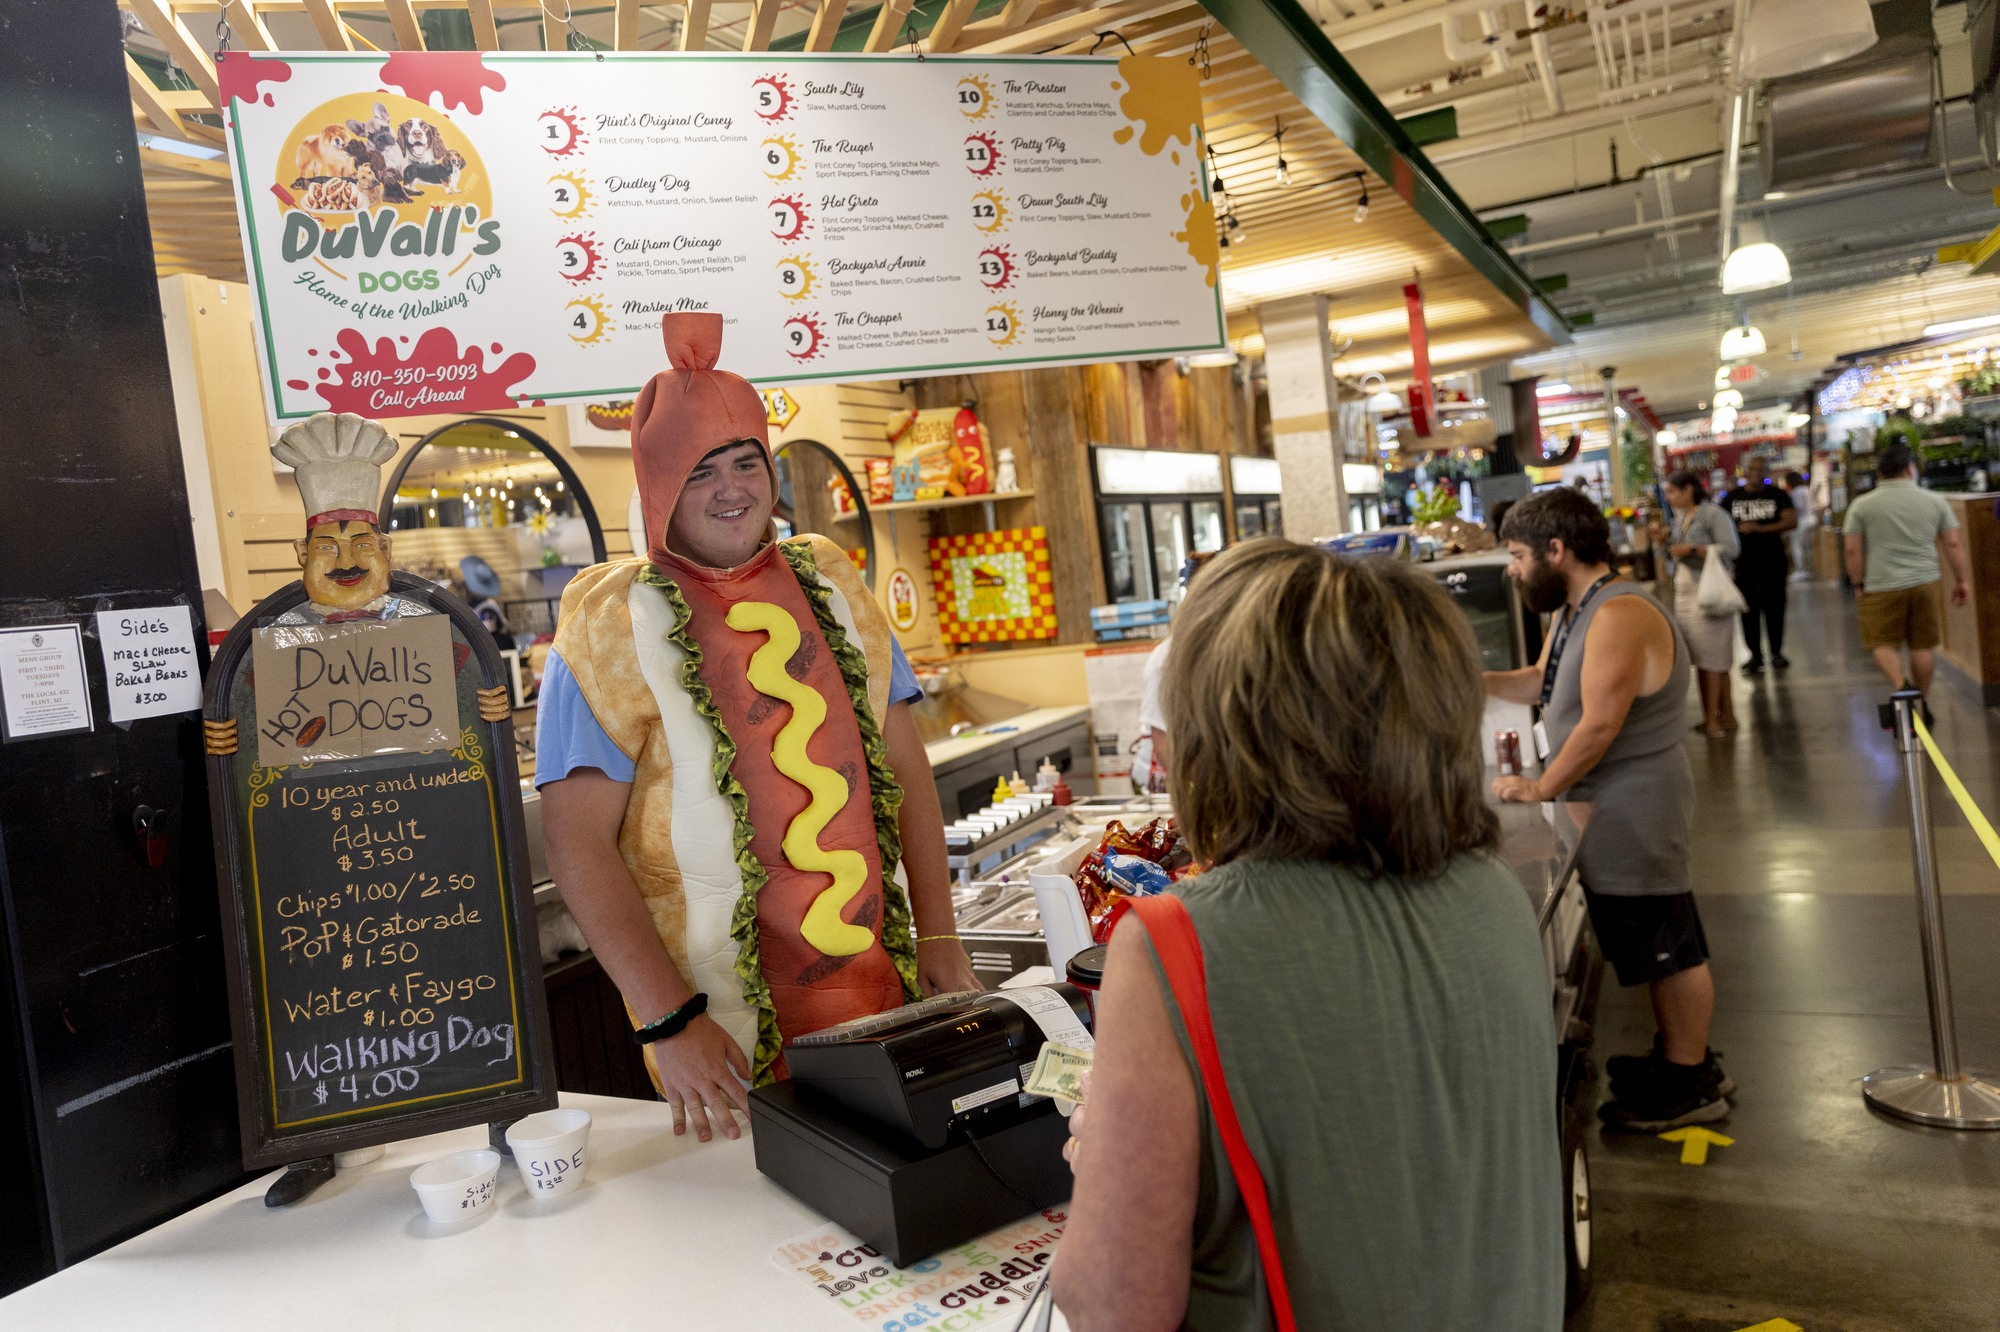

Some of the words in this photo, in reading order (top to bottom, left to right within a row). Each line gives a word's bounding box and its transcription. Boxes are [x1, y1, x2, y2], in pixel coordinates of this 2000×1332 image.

[759, 92, 772, 106] 5
[803, 81, 837, 97] South
[840, 81, 864, 98] Lily
[959, 91, 980, 103] 10
[1004, 80, 1022, 93] The
[1025, 81, 1066, 93] Preston
[547, 125, 559, 138] 1
[596, 114, 636, 131] Flint's
[639, 113, 691, 129] Original
[694, 113, 733, 129] Coney
[620, 137, 644, 145] Coney
[646, 136, 681, 144] Topping,
[721, 134, 747, 142] Onions
[767, 151, 779, 164] 6
[813, 140, 832, 153] The
[836, 140, 873, 155] Ruger
[966, 148, 987, 161] 11
[1011, 138, 1042, 153] Patty
[1045, 137, 1066, 152] Pig
[857, 161, 888, 169] Topping,
[871, 169, 900, 177] Flaming
[554, 188, 569, 202] 2
[605, 176, 656, 193] Dudley
[660, 174, 690, 191] Dog
[608, 199, 643, 207] Ketchup,
[775, 212, 787, 227] 7
[821, 195, 845, 211] Hot
[848, 195, 878, 211] Greta
[973, 205, 994, 218] 12
[1018, 194, 1053, 209] Down
[1054, 193, 1084, 208] South
[1086, 193, 1108, 208] Lily
[281, 205, 501, 263] DuVall's
[563, 251, 578, 266] 3
[614, 237, 639, 253] Cali
[642, 239, 670, 253] from
[673, 235, 722, 253] Chicago
[617, 260, 651, 268] Mustard,
[980, 262, 1001, 275] 13
[1025, 250, 1078, 266] Backyard
[1080, 248, 1117, 264] Buddy
[358, 269, 440, 294] DOGS
[618, 269, 644, 277] Pickle,
[679, 267, 701, 275] Sport
[703, 265, 734, 274] Peppers
[783, 271, 795, 284] 8
[828, 258, 887, 274] Backyard
[887, 256, 926, 271] Annie
[293, 270, 348, 308] Home
[351, 302, 368, 319] of
[369, 304, 394, 319] the
[398, 292, 469, 320] Walking
[466, 264, 501, 294] Dog
[573, 313, 587, 329] 4
[622, 300, 672, 313] Marley
[676, 297, 708, 311] Mac
[987, 317, 1008, 332] 14
[1032, 306, 1068, 322] Honey
[1071, 304, 1085, 316] the
[1087, 302, 1124, 316] Weenie
[790, 331, 803, 345] 9
[835, 312, 854, 326] The
[857, 312, 902, 327] Chopper
[351, 364, 478, 388] 810-350-9093
[370, 388, 402, 410] Call
[405, 386, 466, 409] Ahead
[121, 619, 169, 636] Side's
[291, 646, 432, 692] DuVall's
[135, 693, 167, 704] $3.00
[262, 692, 310, 748] HOT
[329, 693, 432, 736] DOGS
[282, 787, 309, 808] 10
[311, 784, 370, 810] year
[376, 773, 417, 793] and
[333, 819, 426, 851] Adult
[277, 890, 341, 917] Chips
[356, 902, 482, 944] Gatorade
[284, 987, 380, 1023] Water
[406, 972, 495, 1004] Faygo
[364, 1008, 434, 1026] $1.00
[448, 1015, 514, 1066] Dog
[906, 1068, 924, 1078] ROYAL
[531, 1148, 583, 1176] SIDE
[777, 1235, 839, 1264] live
[818, 1266, 888, 1296] love
[838, 1274, 915, 1308] LICK
[855, 1266, 975, 1320] SNOOZE
[940, 1253, 1050, 1308] cuddle
[883, 1302, 941, 1332] eat
